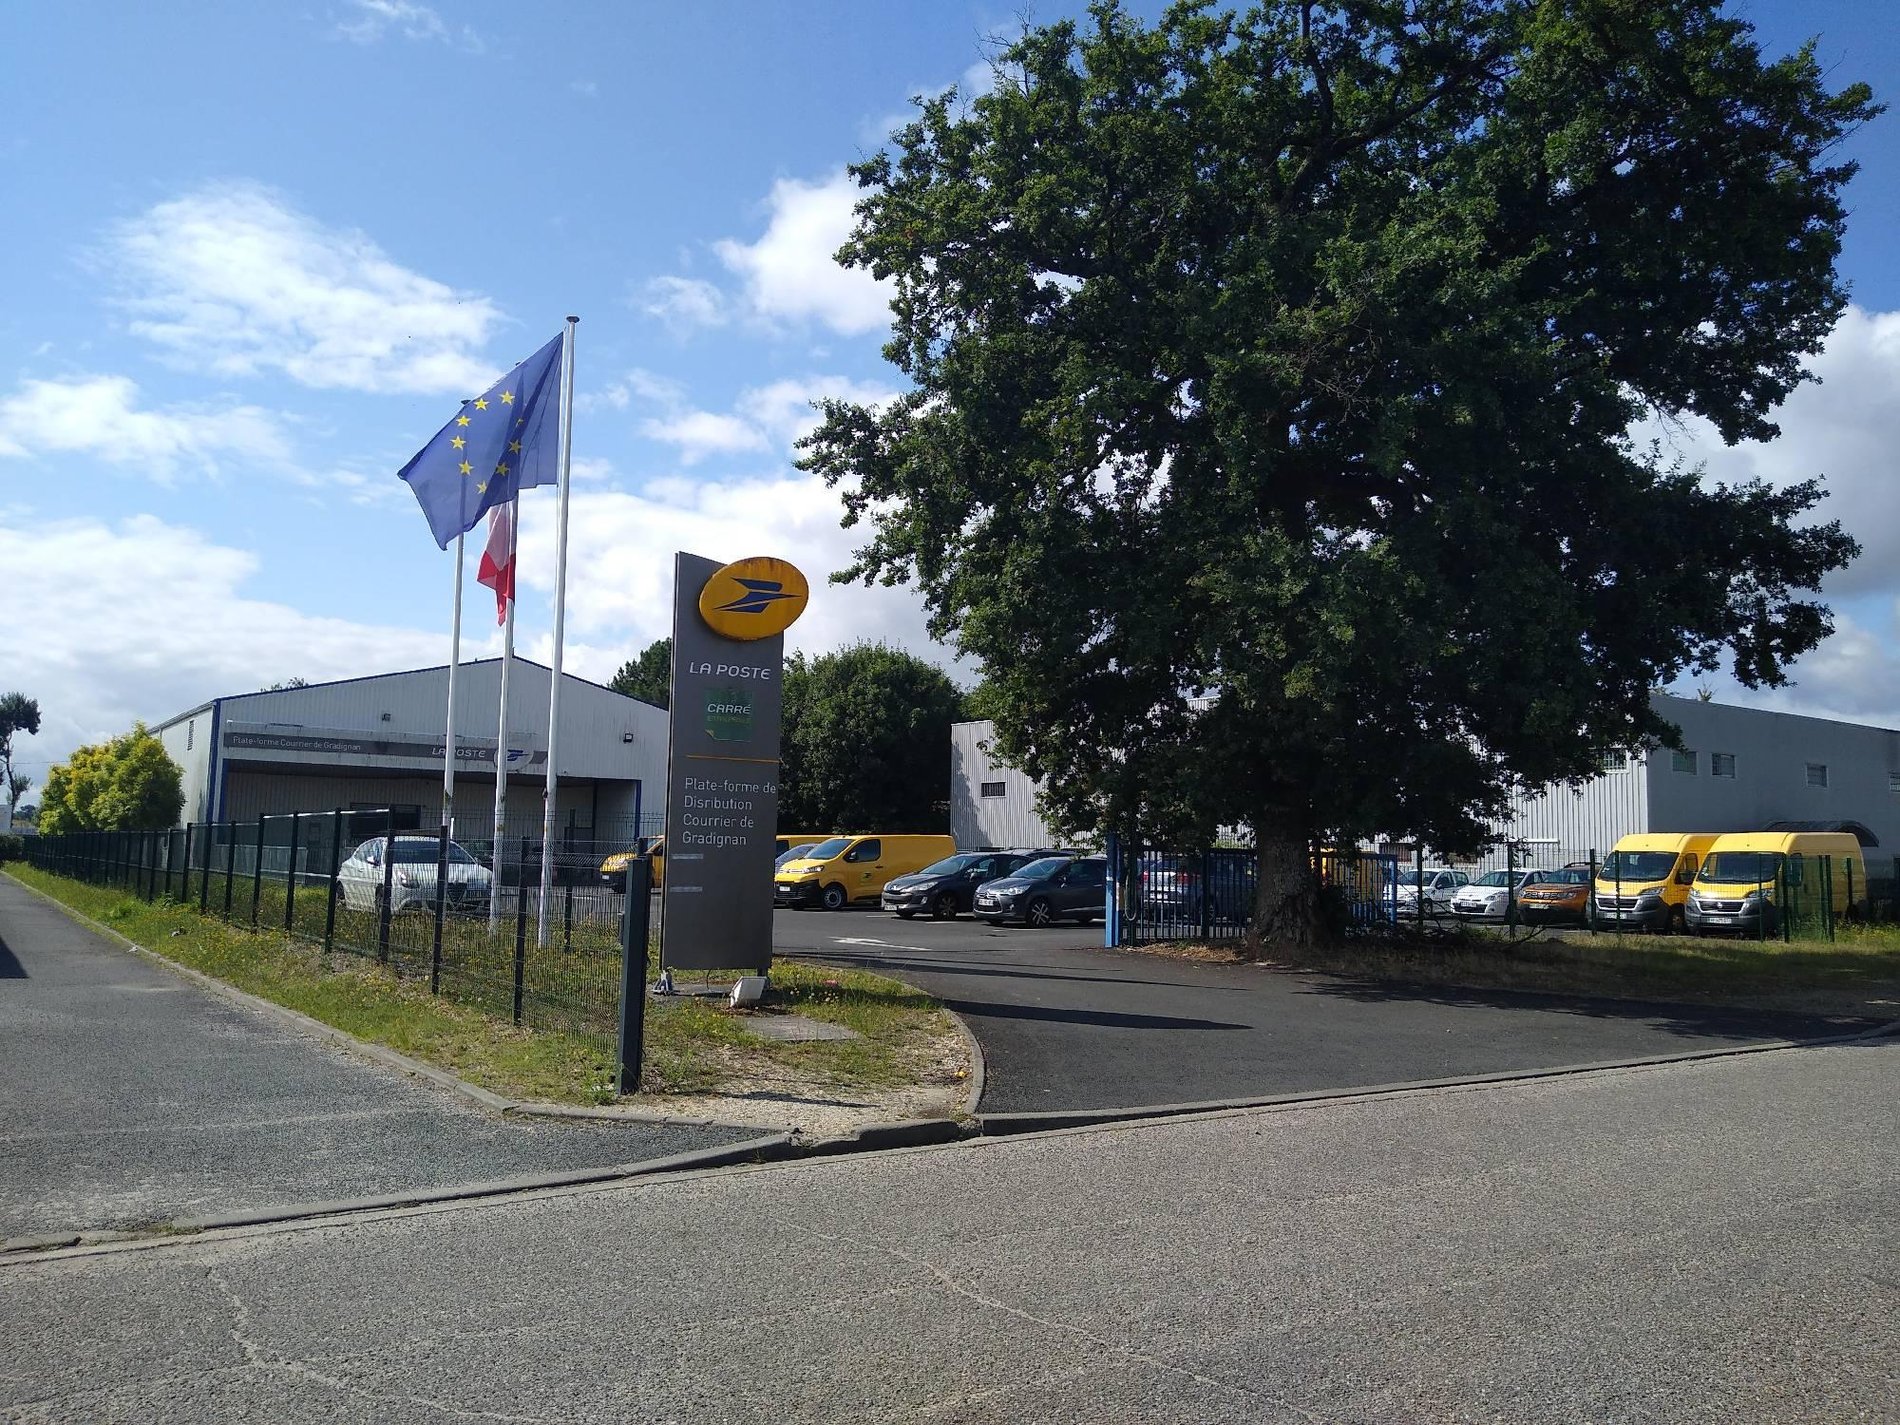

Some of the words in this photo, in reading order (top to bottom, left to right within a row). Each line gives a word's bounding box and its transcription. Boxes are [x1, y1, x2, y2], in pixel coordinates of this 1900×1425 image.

[689, 661, 712, 675] LA
[715, 664, 771, 680] POSTE
[707, 703, 752, 715] CARRÉ
[431, 747, 447, 756] LA
[455, 748, 486, 758] OSTE
[685, 777, 759, 793] Plate-forme
[762, 782, 776, 793] de
[683, 813, 737, 828] Courrier
[740, 815, 754, 828] de
[682, 830, 747, 848] Gradignan
